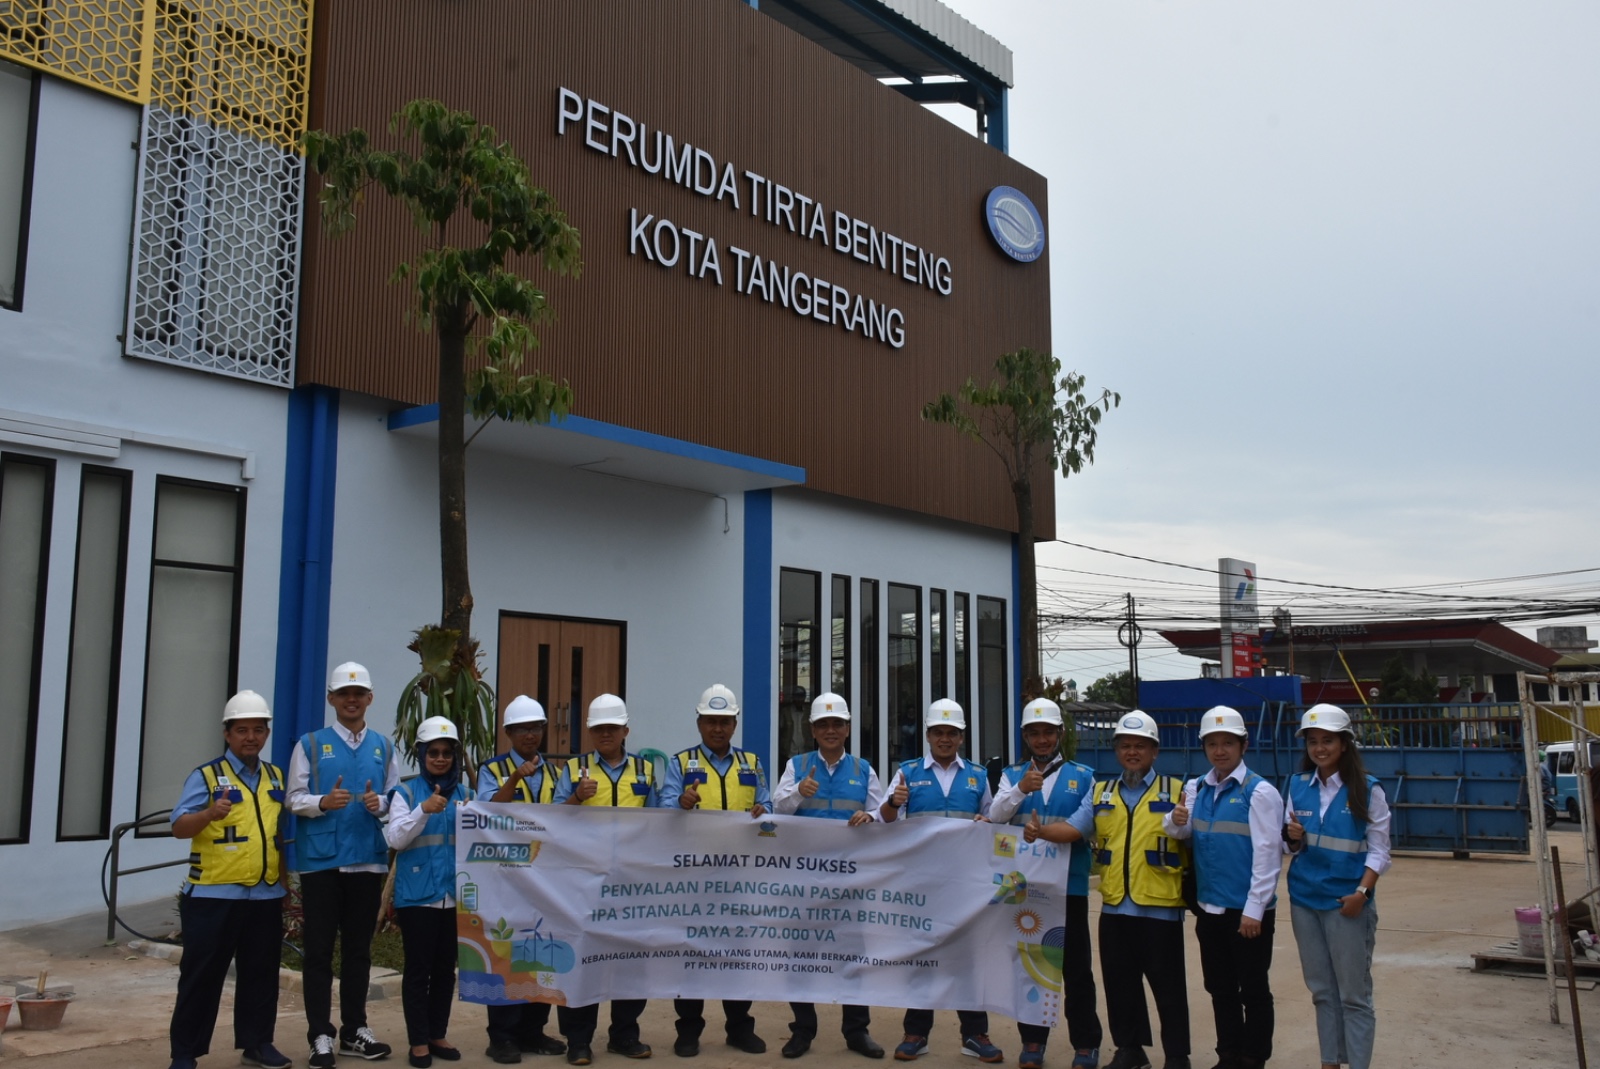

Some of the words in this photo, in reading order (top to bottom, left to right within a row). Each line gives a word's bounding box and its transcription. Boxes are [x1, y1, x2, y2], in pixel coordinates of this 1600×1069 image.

[558, 86, 739, 209] PERUMDA
[745, 170, 829, 246] TIRTA
[835, 210, 952, 295] BENTENG
[630, 208, 723, 285] KOTA
[730, 246, 905, 349] TANGERANG
[473, 845, 529, 859] ROM30
[1018, 842, 1057, 859] PLN
[673, 854, 750, 868] SELAMAT
[754, 855, 791, 869] DAN
[796, 856, 857, 874] SUKSES
[601, 881, 699, 898] PENYALAAN
[704, 881, 805, 898] PELANGGAN
[810, 885, 876, 901] PASANG
[881, 889, 926, 907] BARU
[591, 908, 618, 922] IPA
[622, 903, 702, 919] SITANALA
[706, 903, 715, 916] 2
[720, 903, 801, 920] PERUMDA
[806, 907, 852, 922] TIRTA
[857, 909, 933, 931] BENTENG
[686, 926, 731, 938] DAYA
[735, 926, 810, 941] 2.770.000
[814, 929, 836, 942] VA
[581, 951, 650, 965] KEBAHAGIAAN
[652, 950, 680, 958] ANDA
[682, 949, 722, 957] ADALAH
[724, 949, 751, 957] YANG
[753, 949, 791, 960] UTAMA,
[793, 951, 819, 960] KAMI
[821, 952, 870, 965] BERKARYA
[872, 958, 913, 967] DENGAN
[684, 961, 696, 970] PT
[698, 961, 717, 970] PLN
[719, 961, 769, 971] (PERSERO)
[771, 963, 789, 971] UP3
[791, 963, 834, 974] CIKOKOL
